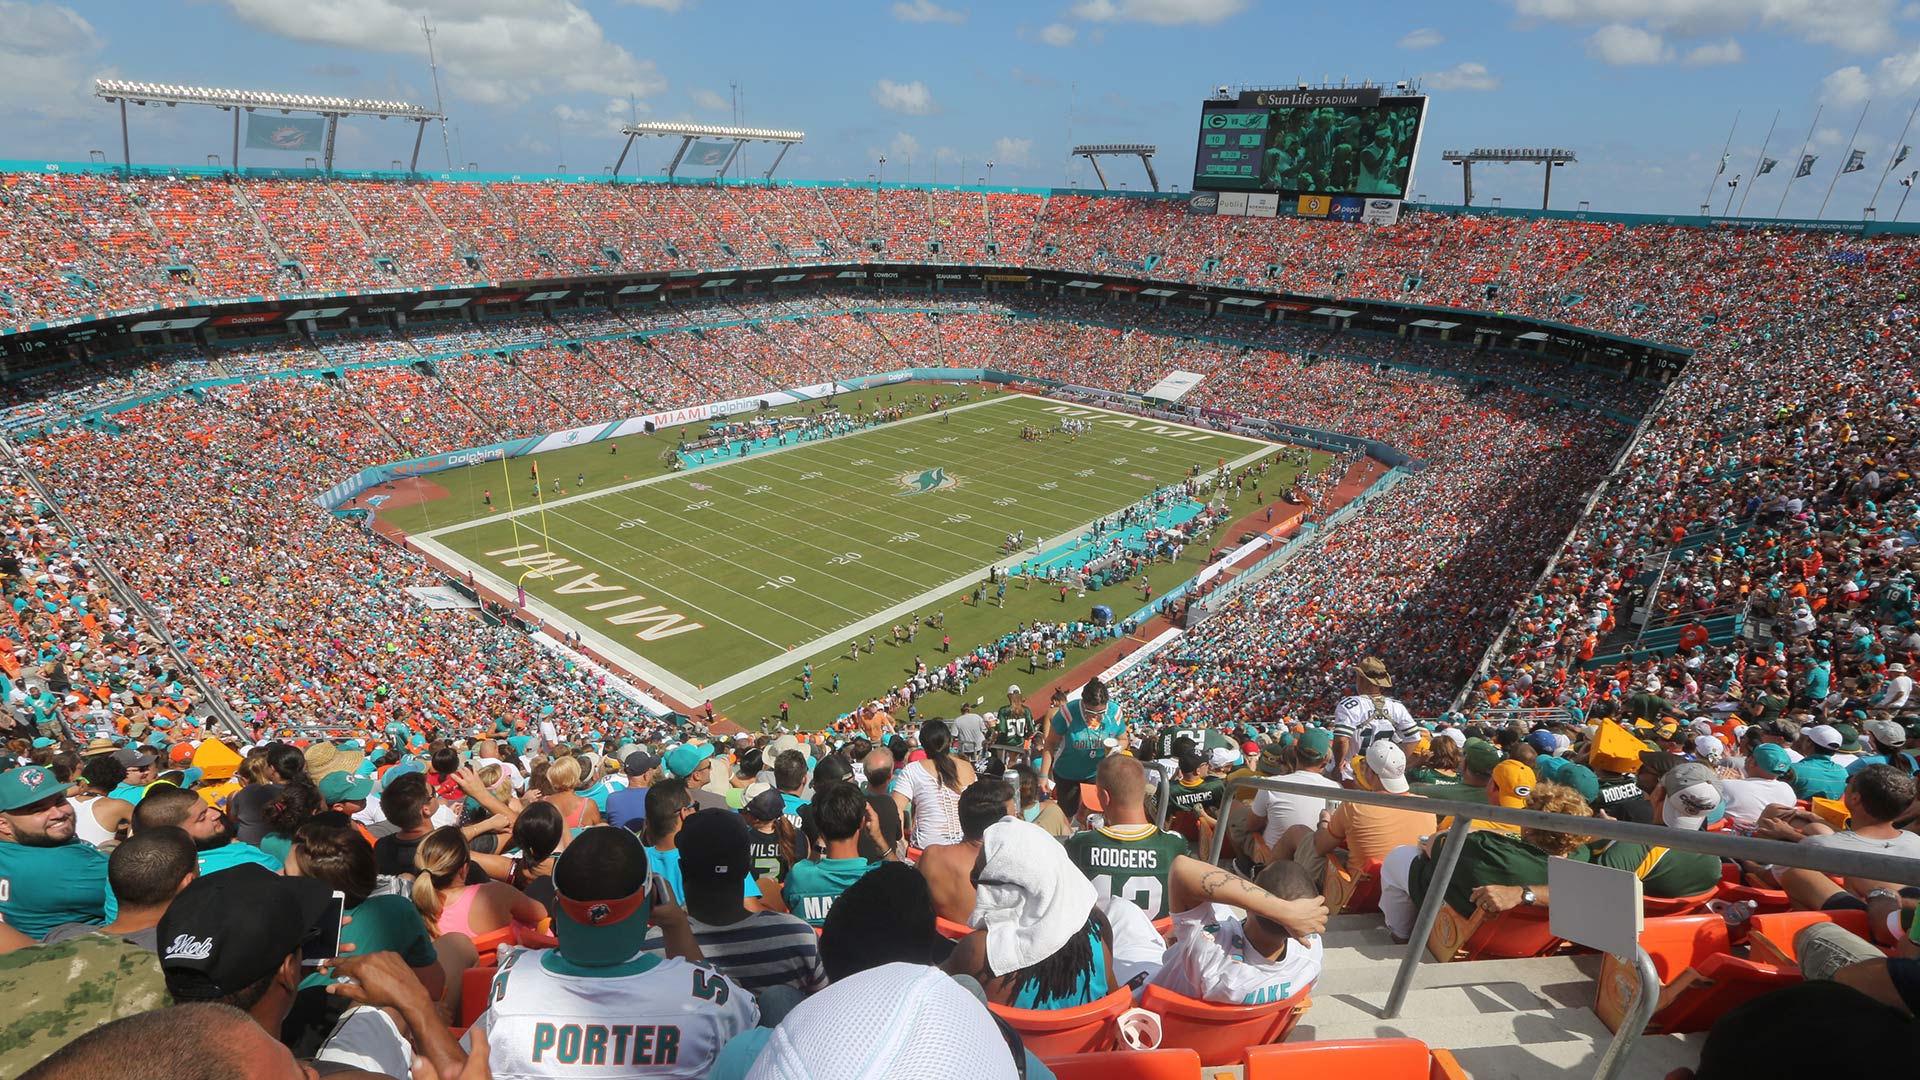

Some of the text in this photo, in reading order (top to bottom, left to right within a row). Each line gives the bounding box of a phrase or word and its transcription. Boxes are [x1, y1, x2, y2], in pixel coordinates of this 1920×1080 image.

[1268, 93, 1358, 105] Sun Life STADIUM
[1208, 114, 1227, 128] G
[1211, 136, 1220, 144] 10
[1220, 200, 1243, 208] Publix
[368, 306, 396, 314] Dolphins
[231, 316, 265, 324] Dolphins
[20, 342, 33, 352] 10
[1657, 359, 1667, 368] 10
[654, 398, 760, 426] MIAMI Dolphins
[1042, 406, 1215, 442] MIAMI
[393, 449, 504, 475] MIAMI Dolphins
[995, 497, 1018, 507] 50
[950, 513, 972, 523] 40
[898, 531, 921, 543] 30
[831, 551, 862, 565] 20
[766, 575, 796, 590] 10
[483, 543, 706, 642] MIAMI
[1886, 589, 1900, 601] 19
[1340, 696, 1359, 710] 18
[1006, 718, 1026, 737] 50
[1176, 790, 1213, 805] MATTHEWS
[1514, 786, 1531, 796] G
[1602, 782, 1642, 803] RODGERS
[1091, 847, 1157, 869] RODGERS
[165, 933, 213, 957] Mob
[531, 1021, 682, 1066] PORTER
